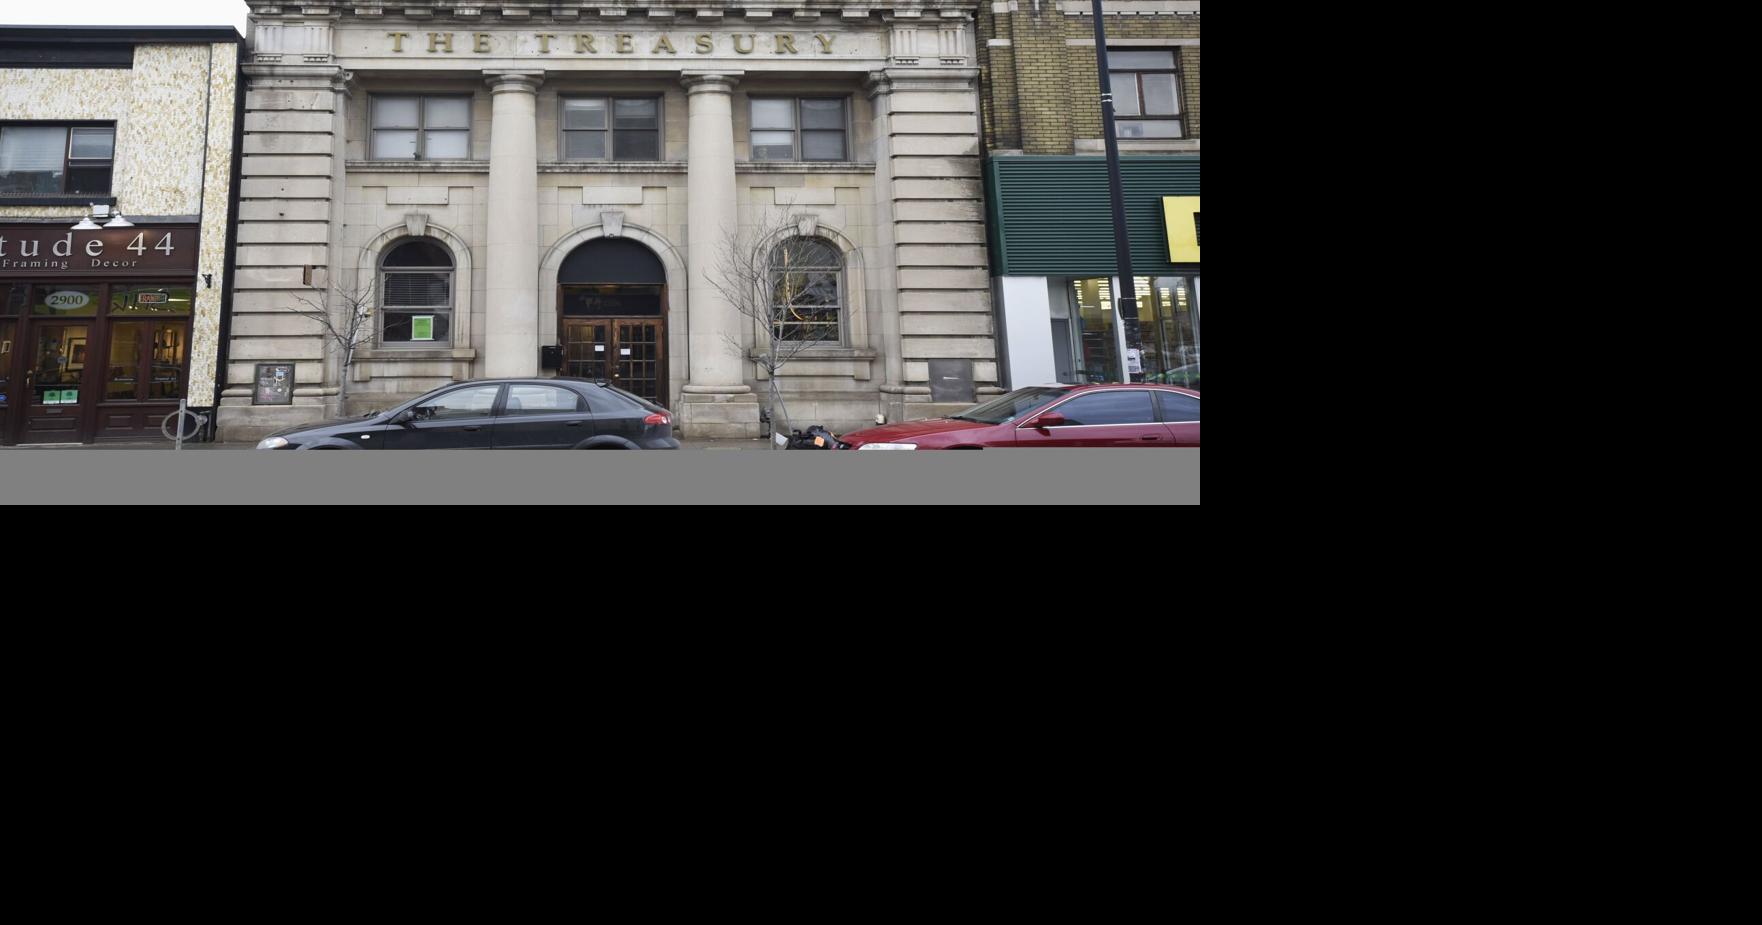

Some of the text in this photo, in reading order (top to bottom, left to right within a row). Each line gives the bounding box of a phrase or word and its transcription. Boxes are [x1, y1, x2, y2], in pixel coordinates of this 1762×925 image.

[386, 31, 838, 55] THE TREASURY
[0, 232, 175, 256] tude 44
[2, 258, 138, 270] Framing Decor
[51, 295, 83, 305] 2900
